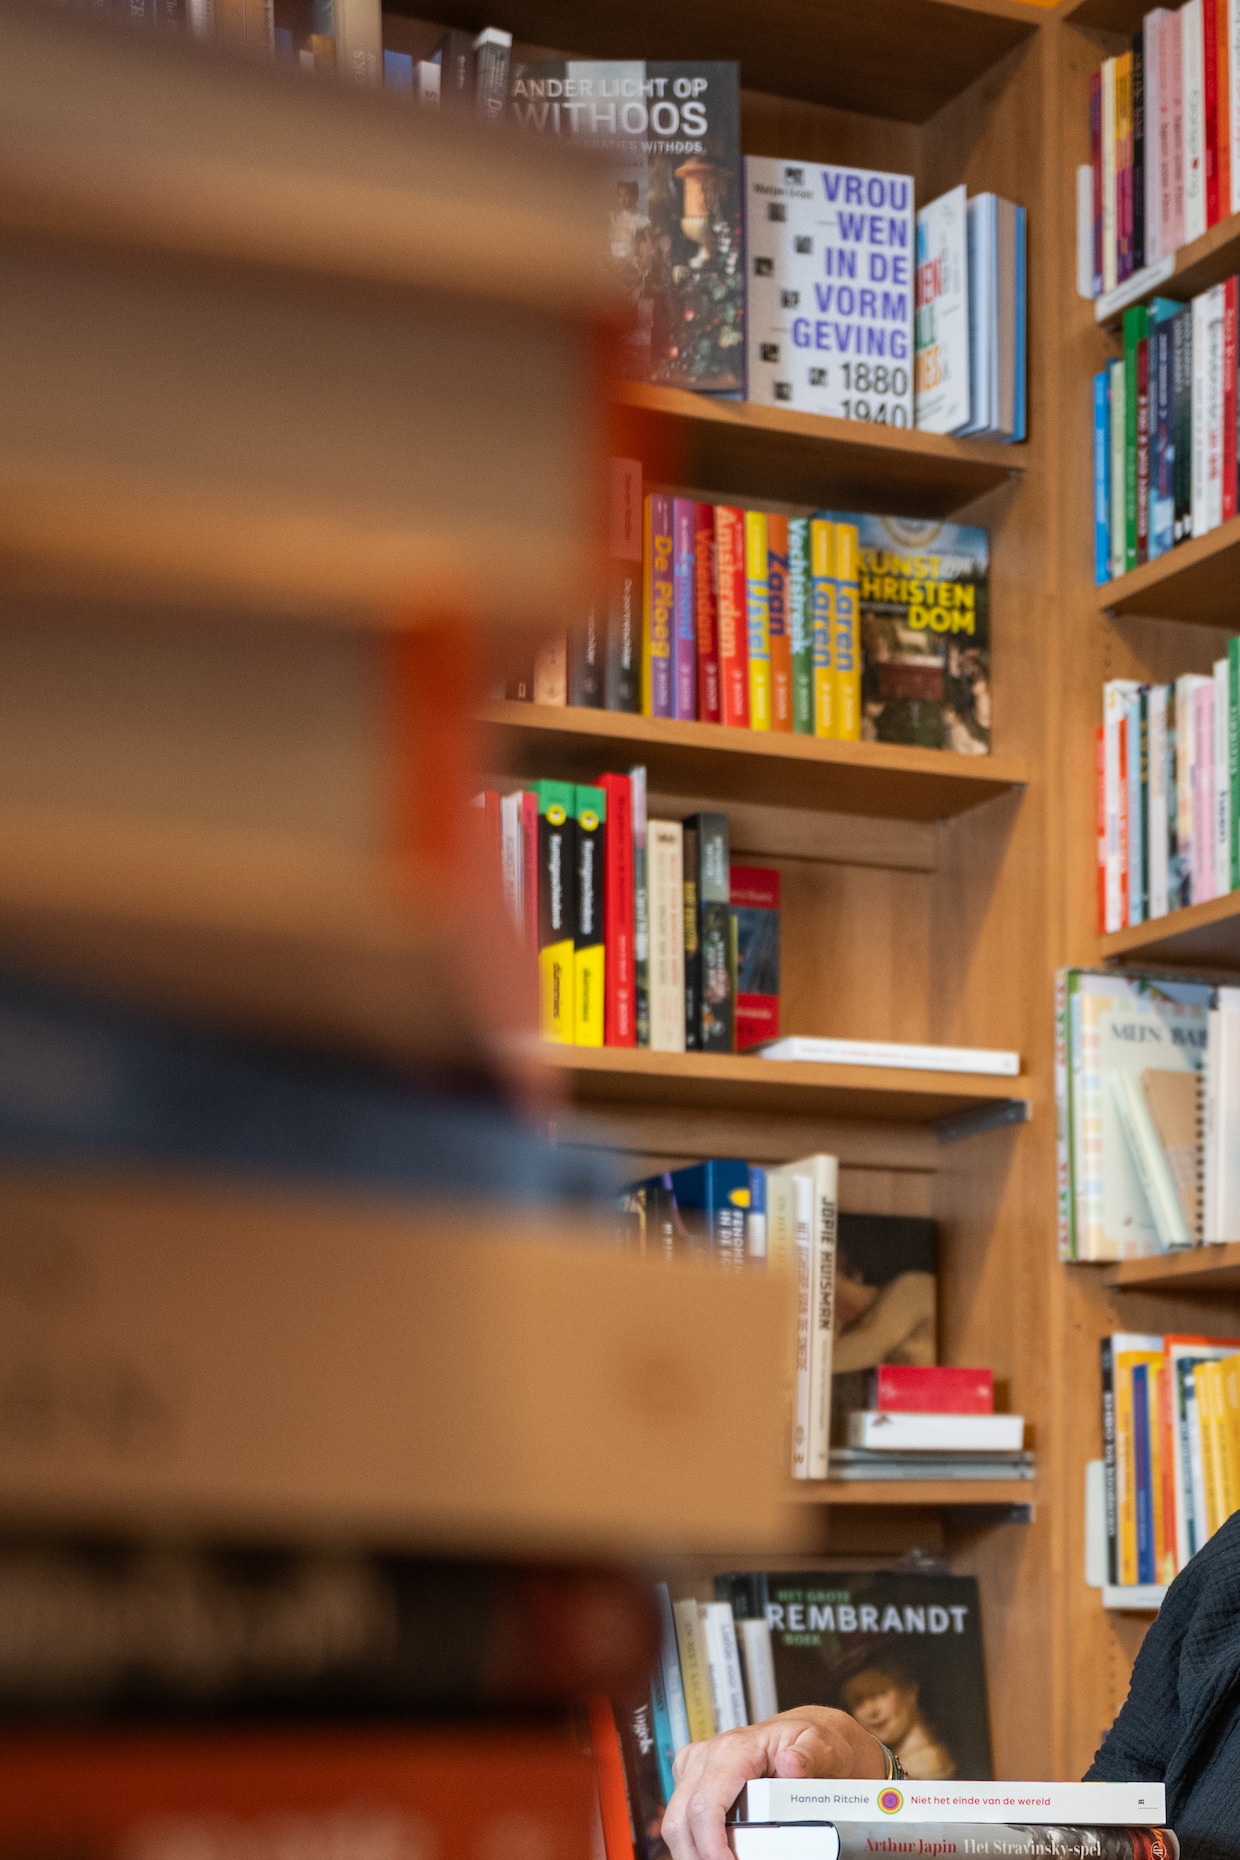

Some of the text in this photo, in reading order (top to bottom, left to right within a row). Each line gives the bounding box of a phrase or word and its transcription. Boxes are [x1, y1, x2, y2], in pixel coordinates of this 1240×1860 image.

[514, 78, 708, 97] ANDER LICHT OP
[513, 102, 708, 136] WITHOOS
[642, 141, 703, 153] WITHOOS
[821, 171, 909, 212] VROU
[836, 210, 909, 249] WEN
[825, 246, 909, 285] IN DE
[814, 283, 909, 323] VORM
[791, 317, 909, 360] GEVING
[840, 362, 908, 398] 1880
[840, 398, 908, 429] 1940
[650, 535, 673, 658] De Ploeg
[714, 506, 741, 658] Amsterdam
[767, 549, 789, 636] Zaan
[747, 578, 770, 660] IJssel
[812, 576, 837, 668] Laren
[836, 581, 859, 671] Laren
[907, 605, 976, 635] DOM
[818, 1196, 835, 1331] JOPIE HUISMAN
[766, 1604, 968, 1635] REMBRANDT
[790, 1794, 870, 1805] Hannah Ritchie
[911, 1795, 1051, 1806] Niet het einde van de wereld
[864, 1837, 957, 1855] Arthur Japin
[963, 1838, 1101, 1859] Het Stravinsky-spel
